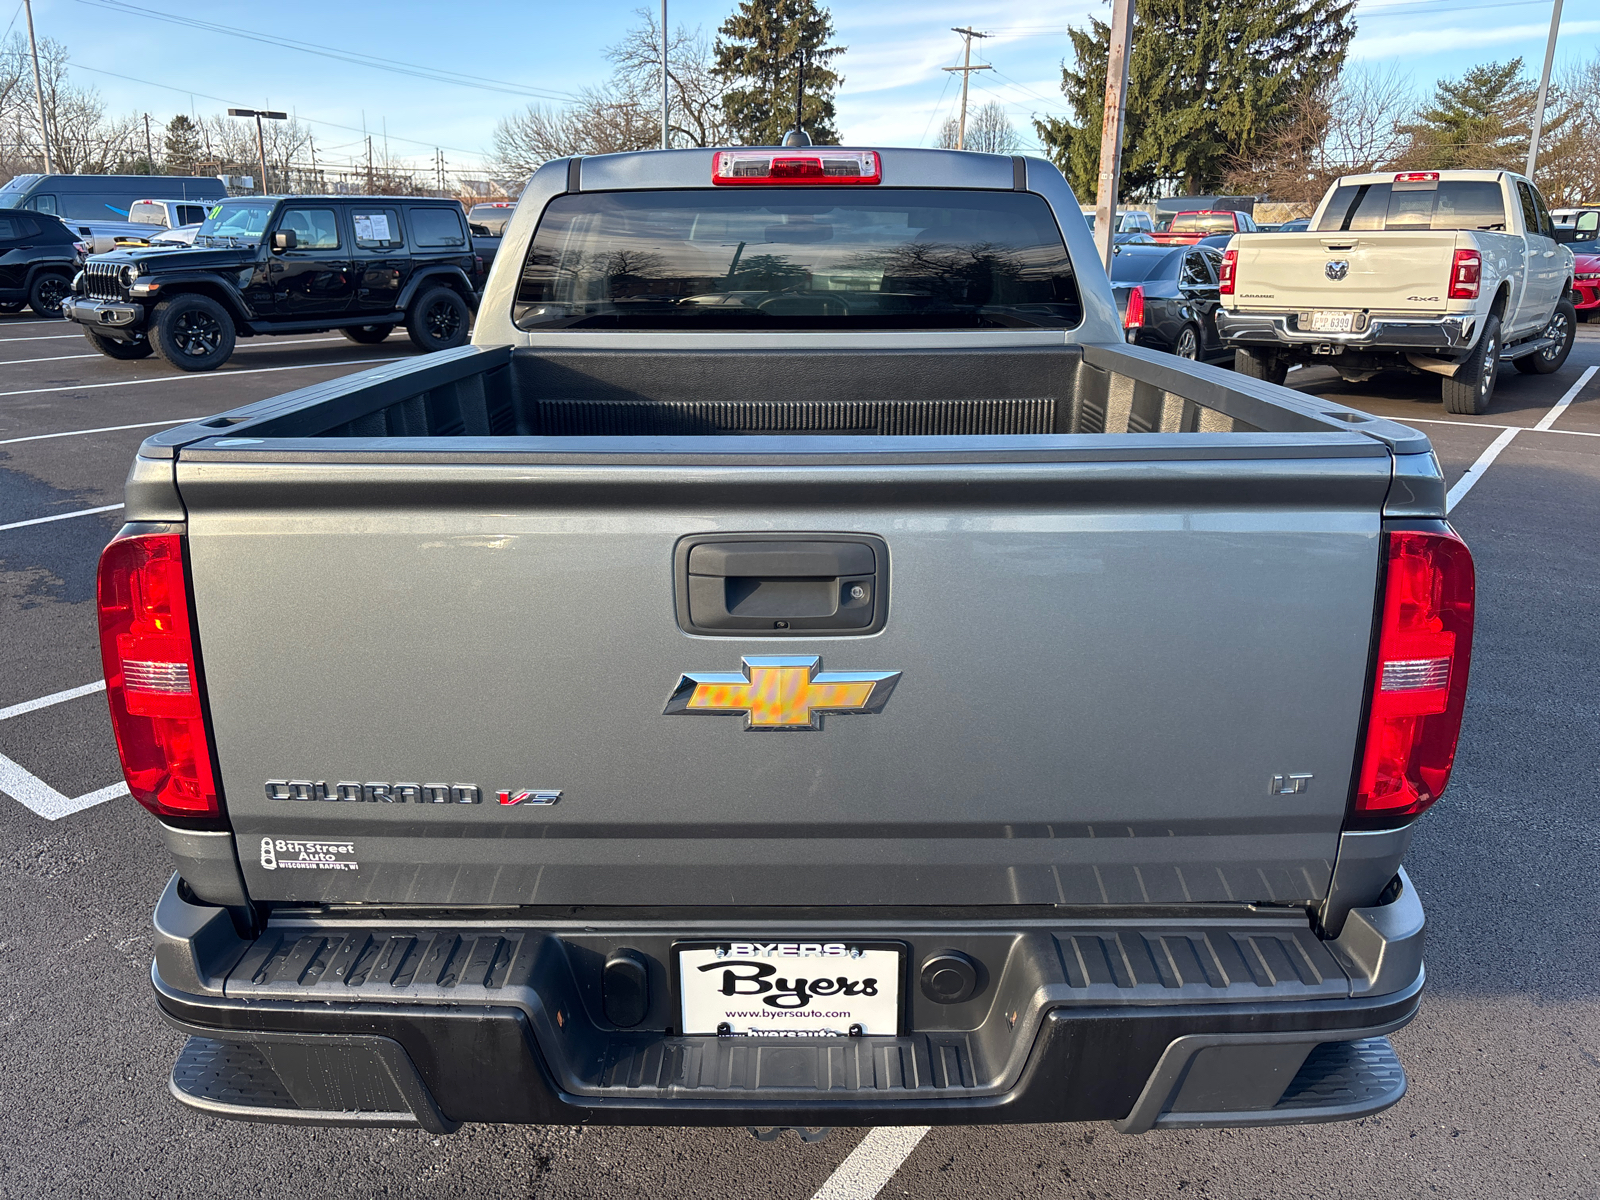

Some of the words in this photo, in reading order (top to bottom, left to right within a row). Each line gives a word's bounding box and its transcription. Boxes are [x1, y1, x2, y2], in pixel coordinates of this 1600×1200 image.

[1330, 317, 1350, 328] 6399
[1271, 774, 1314, 795] LT
[264, 779, 480, 804] COLORADO
[495, 788, 562, 806] V6
[275, 840, 304, 852] 8th
[306, 843, 355, 854] Street
[299, 851, 336, 861] Auto
[730, 943, 848, 958] BYERS
[697, 960, 879, 1009] Byers
[725, 1008, 851, 1020] www.byersauto.com
